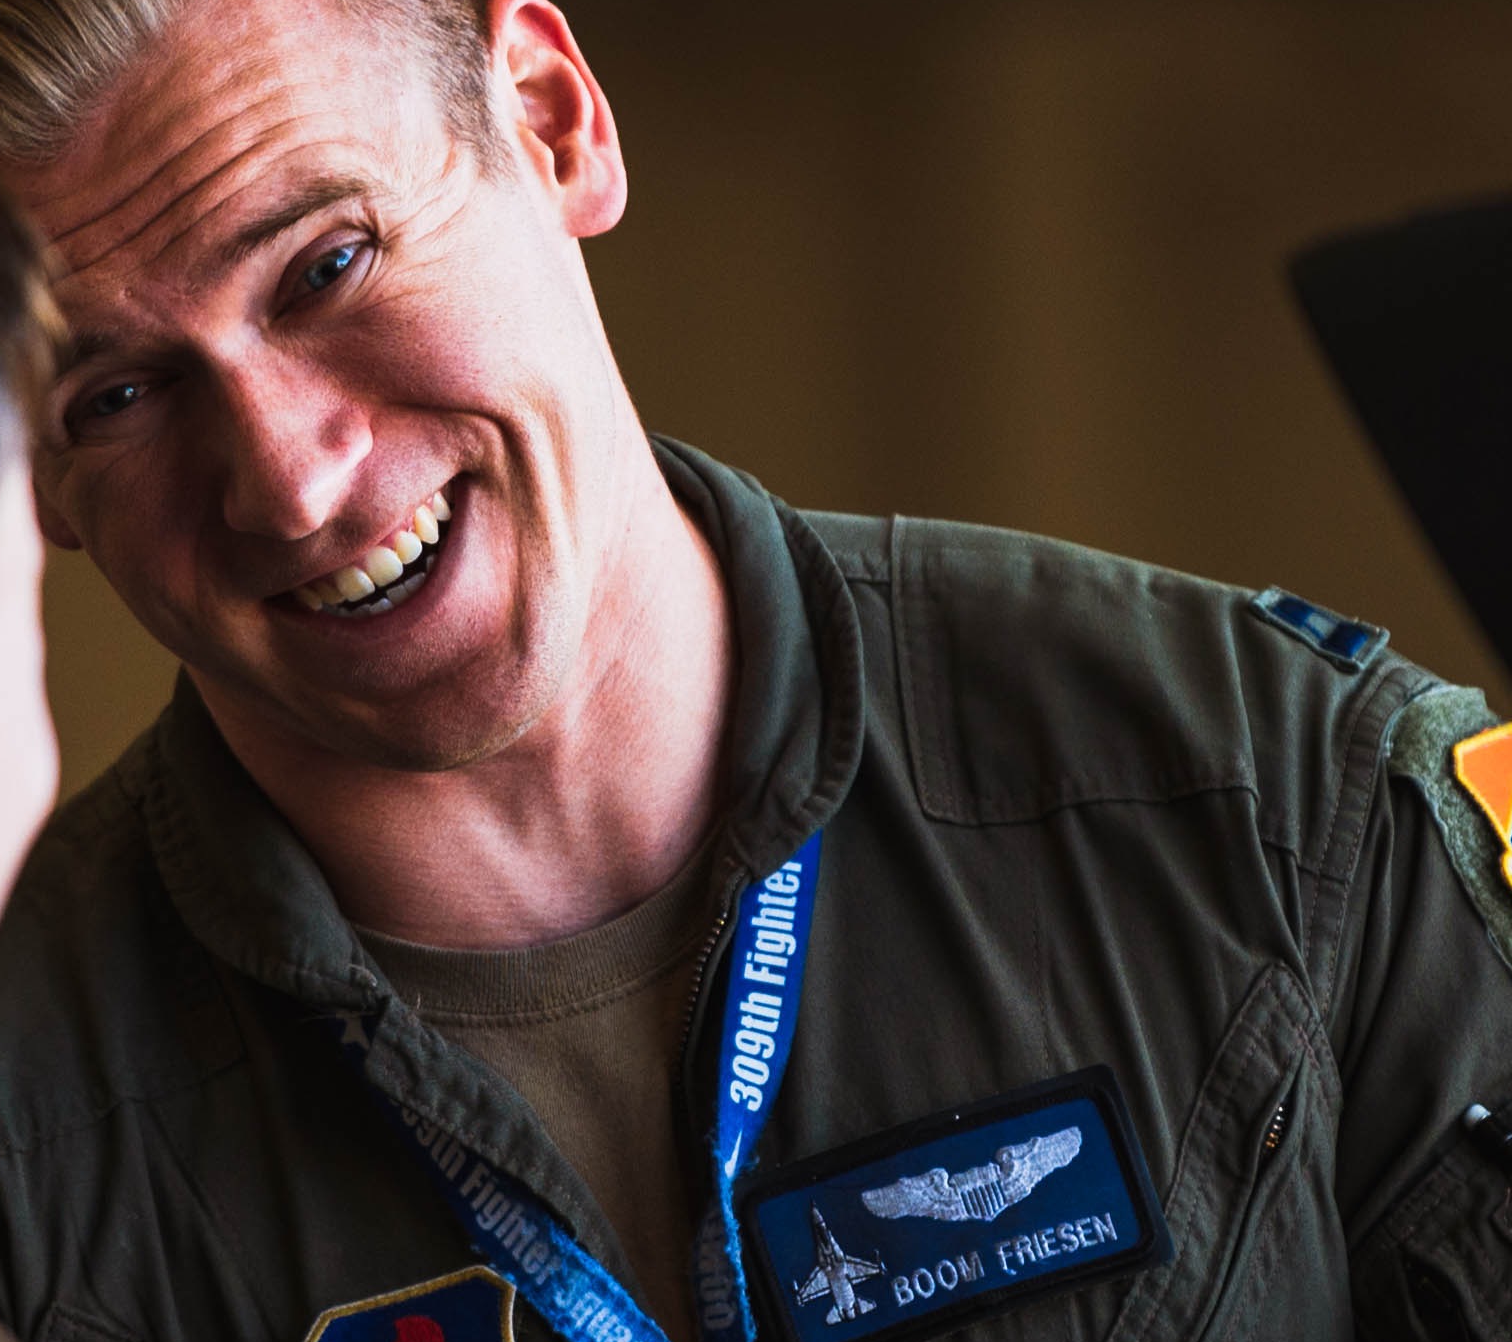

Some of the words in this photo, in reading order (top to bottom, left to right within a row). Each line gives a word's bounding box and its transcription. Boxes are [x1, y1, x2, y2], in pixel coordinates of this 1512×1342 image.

[729, 991, 782, 1112] 309th
[891, 1251, 985, 1307] BOOM
[995, 1212, 1118, 1275] FRIESEN
